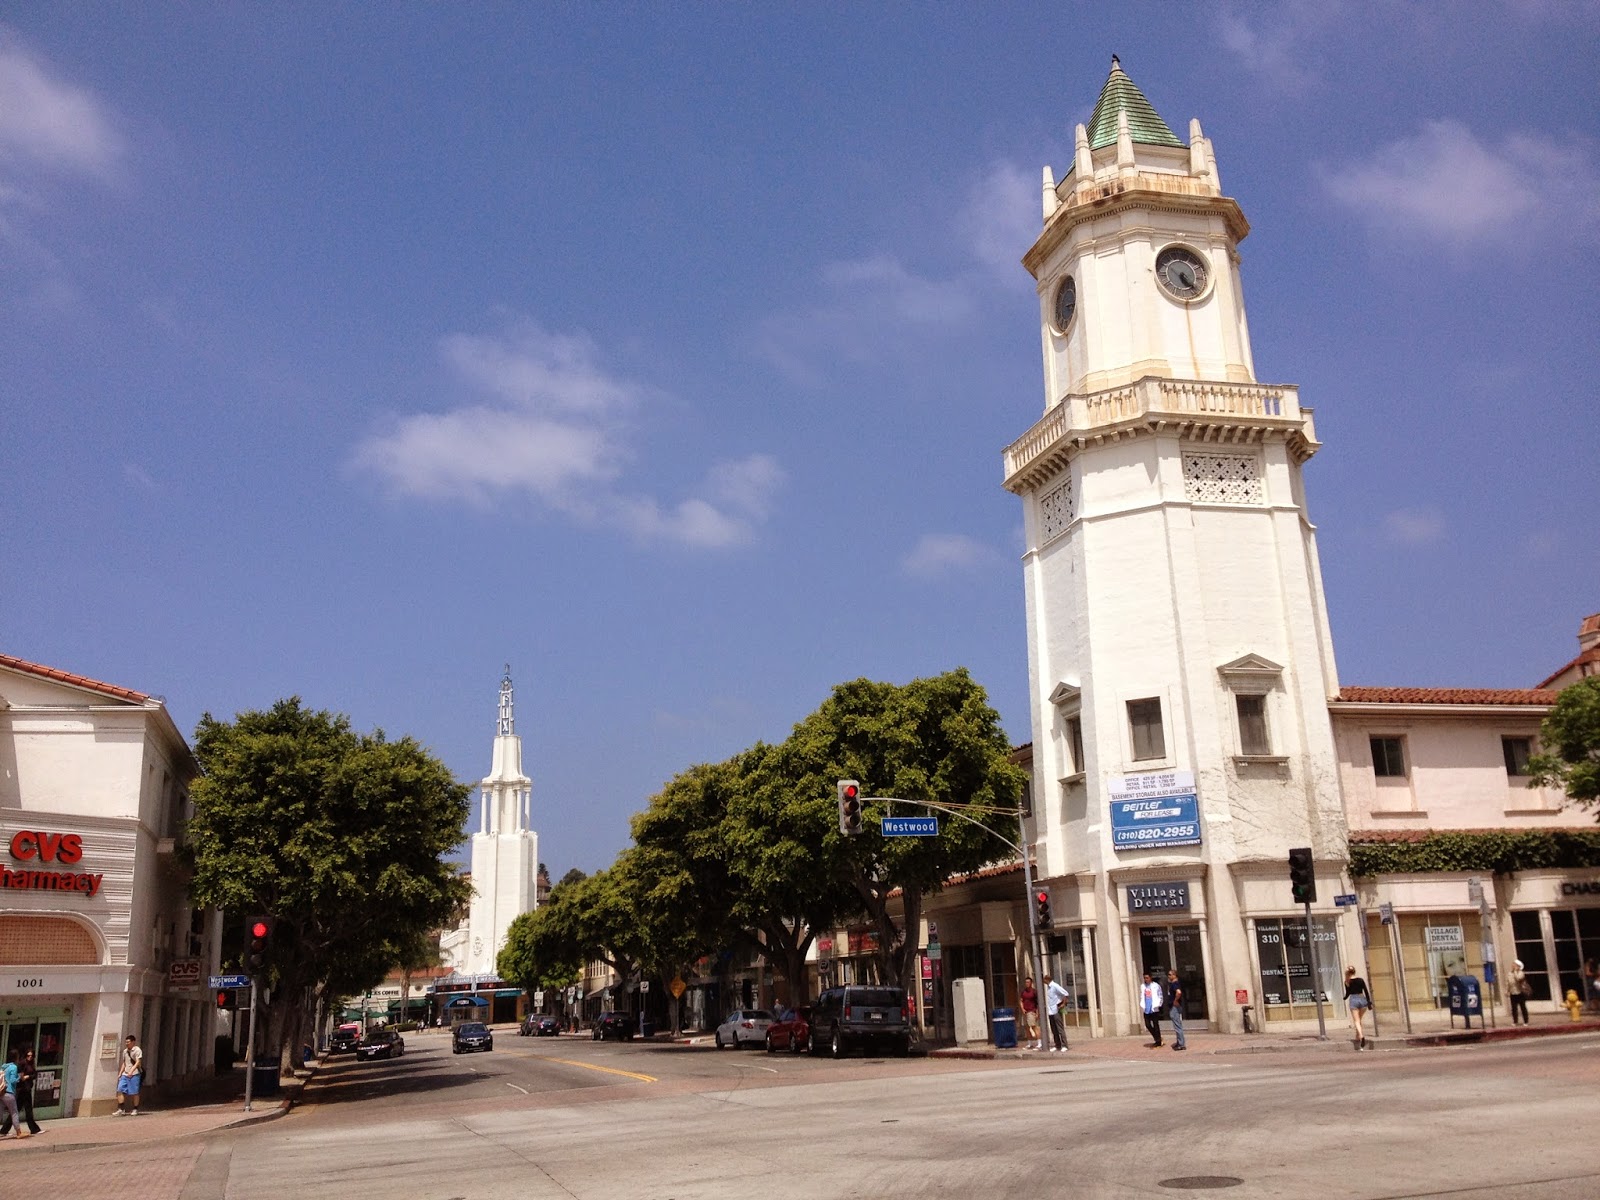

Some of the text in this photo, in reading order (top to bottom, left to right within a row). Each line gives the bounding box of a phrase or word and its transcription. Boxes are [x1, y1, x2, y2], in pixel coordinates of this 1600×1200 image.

[884, 821, 934, 832] Westwood
[10, 830, 83, 864] CVS
[0, 864, 103, 896] harmacy
[1130, 887, 1185, 898] Village
[1562, 882, 1600, 895] CHAS
[1134, 896, 1184, 908] Dental
[1261, 934, 1280, 943] 310
[1313, 932, 1336, 941] 2225
[171, 962, 199, 974] CVS
[17, 978, 43, 988] 1001
